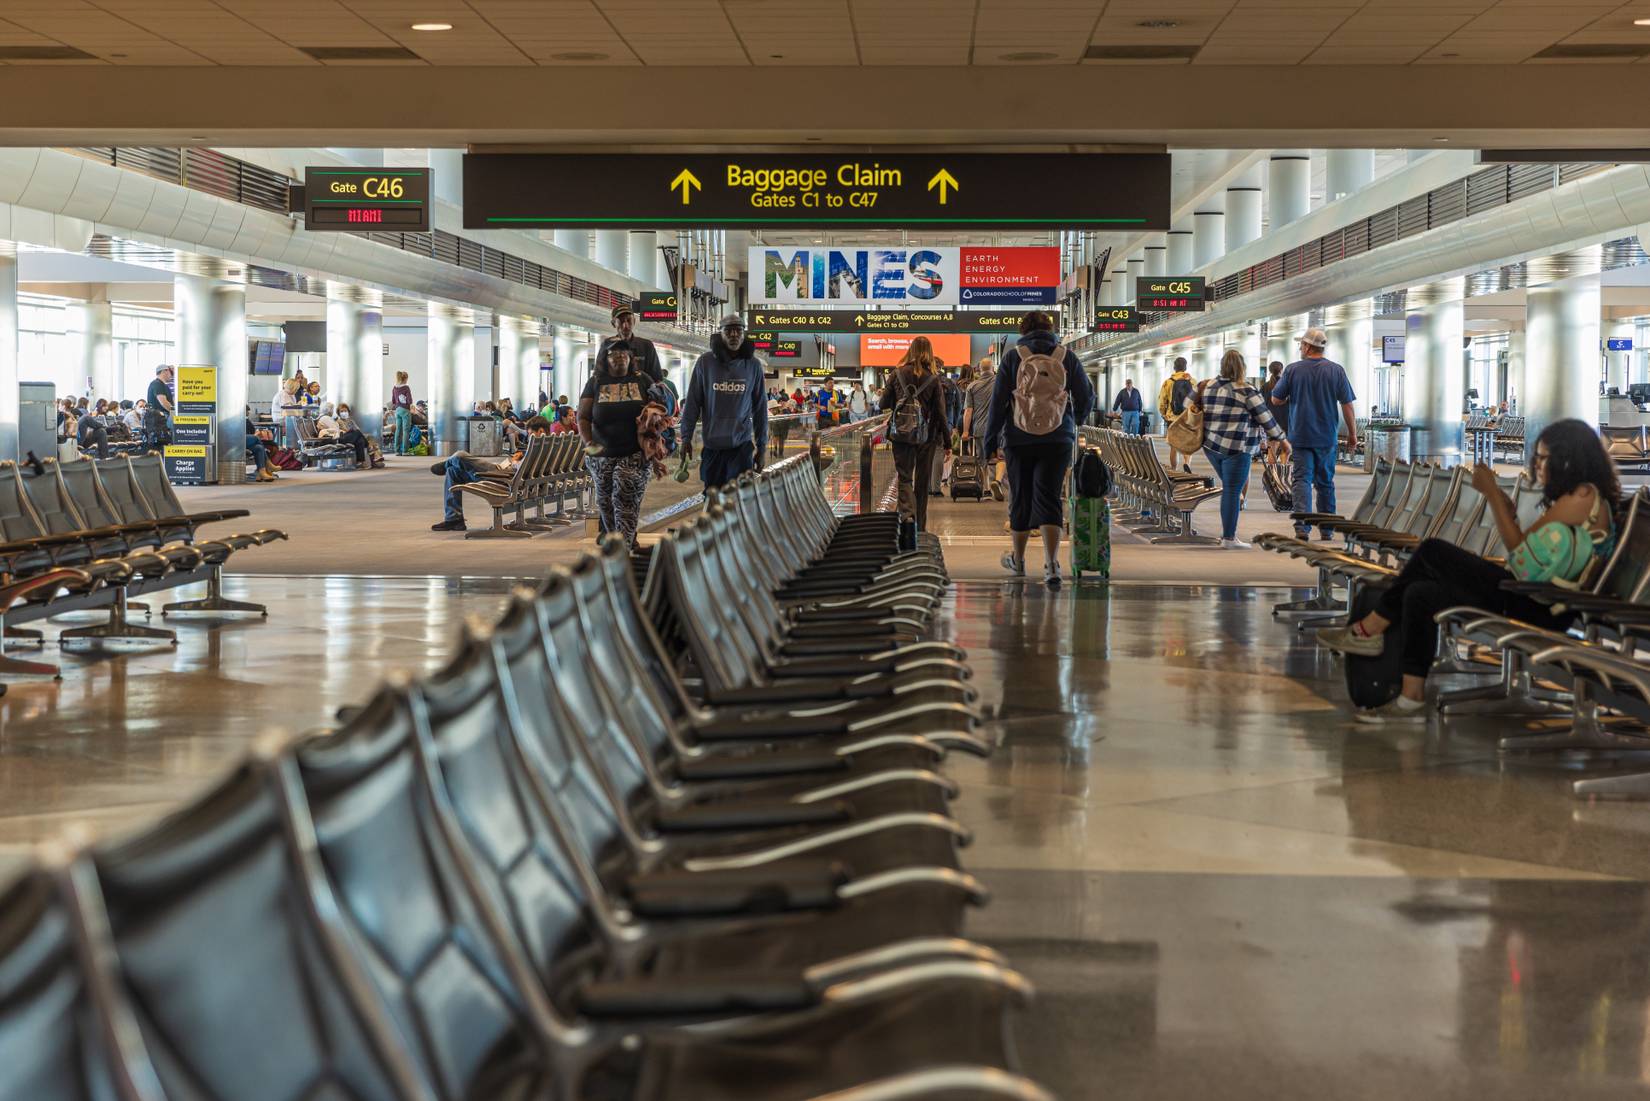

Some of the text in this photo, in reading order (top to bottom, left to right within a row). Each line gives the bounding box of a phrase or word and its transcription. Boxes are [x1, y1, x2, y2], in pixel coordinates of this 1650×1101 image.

[727, 163, 902, 191] Baggage Claim
[330, 178, 404, 198] Gate C46
[751, 193, 878, 207] Gates C1 to C47
[348, 210, 382, 222] MIAMI
[765, 250, 944, 300] MINES
[965, 276, 1039, 284] ENVIRONMENT
[1151, 282, 1191, 294] Gate C45
[769, 316, 832, 324] Gates C40 & C42
[1111, 310, 1129, 319] C43
[979, 317, 1000, 325] Gates
[1002, 317, 1015, 325] C41
[712, 382, 746, 392] adidas
